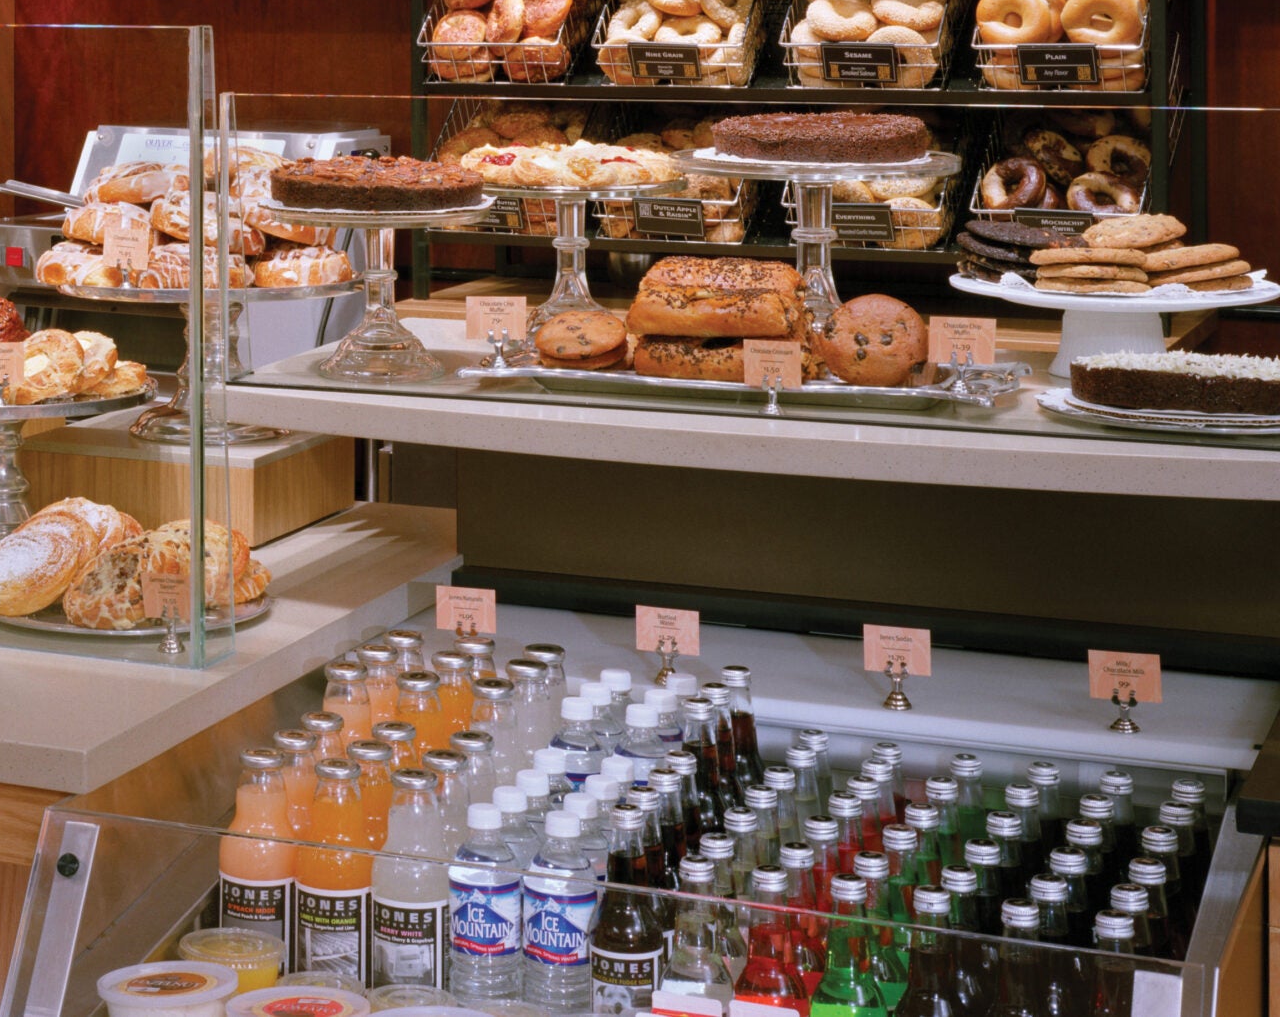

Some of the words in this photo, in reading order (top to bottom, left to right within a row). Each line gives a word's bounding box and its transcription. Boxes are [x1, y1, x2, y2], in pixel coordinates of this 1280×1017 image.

[844, 51, 872, 59] SESAME
[676, 206, 697, 214] APPLE
[835, 213, 876, 221] EVERYTHING
[1040, 218, 1084, 226] MOCHACHIP
[224, 884, 282, 900] JONES
[299, 894, 358, 911] JONES
[330, 917, 357, 925] ORANGE
[375, 904, 433, 923] JONES
[467, 903, 486, 923] ICE
[452, 915, 511, 939] MOUNTAIN
[541, 911, 560, 932] ICE
[401, 929, 423, 937] WHITE
[525, 922, 585, 948] MOUNTAIN
[592, 956, 652, 974] JONES
